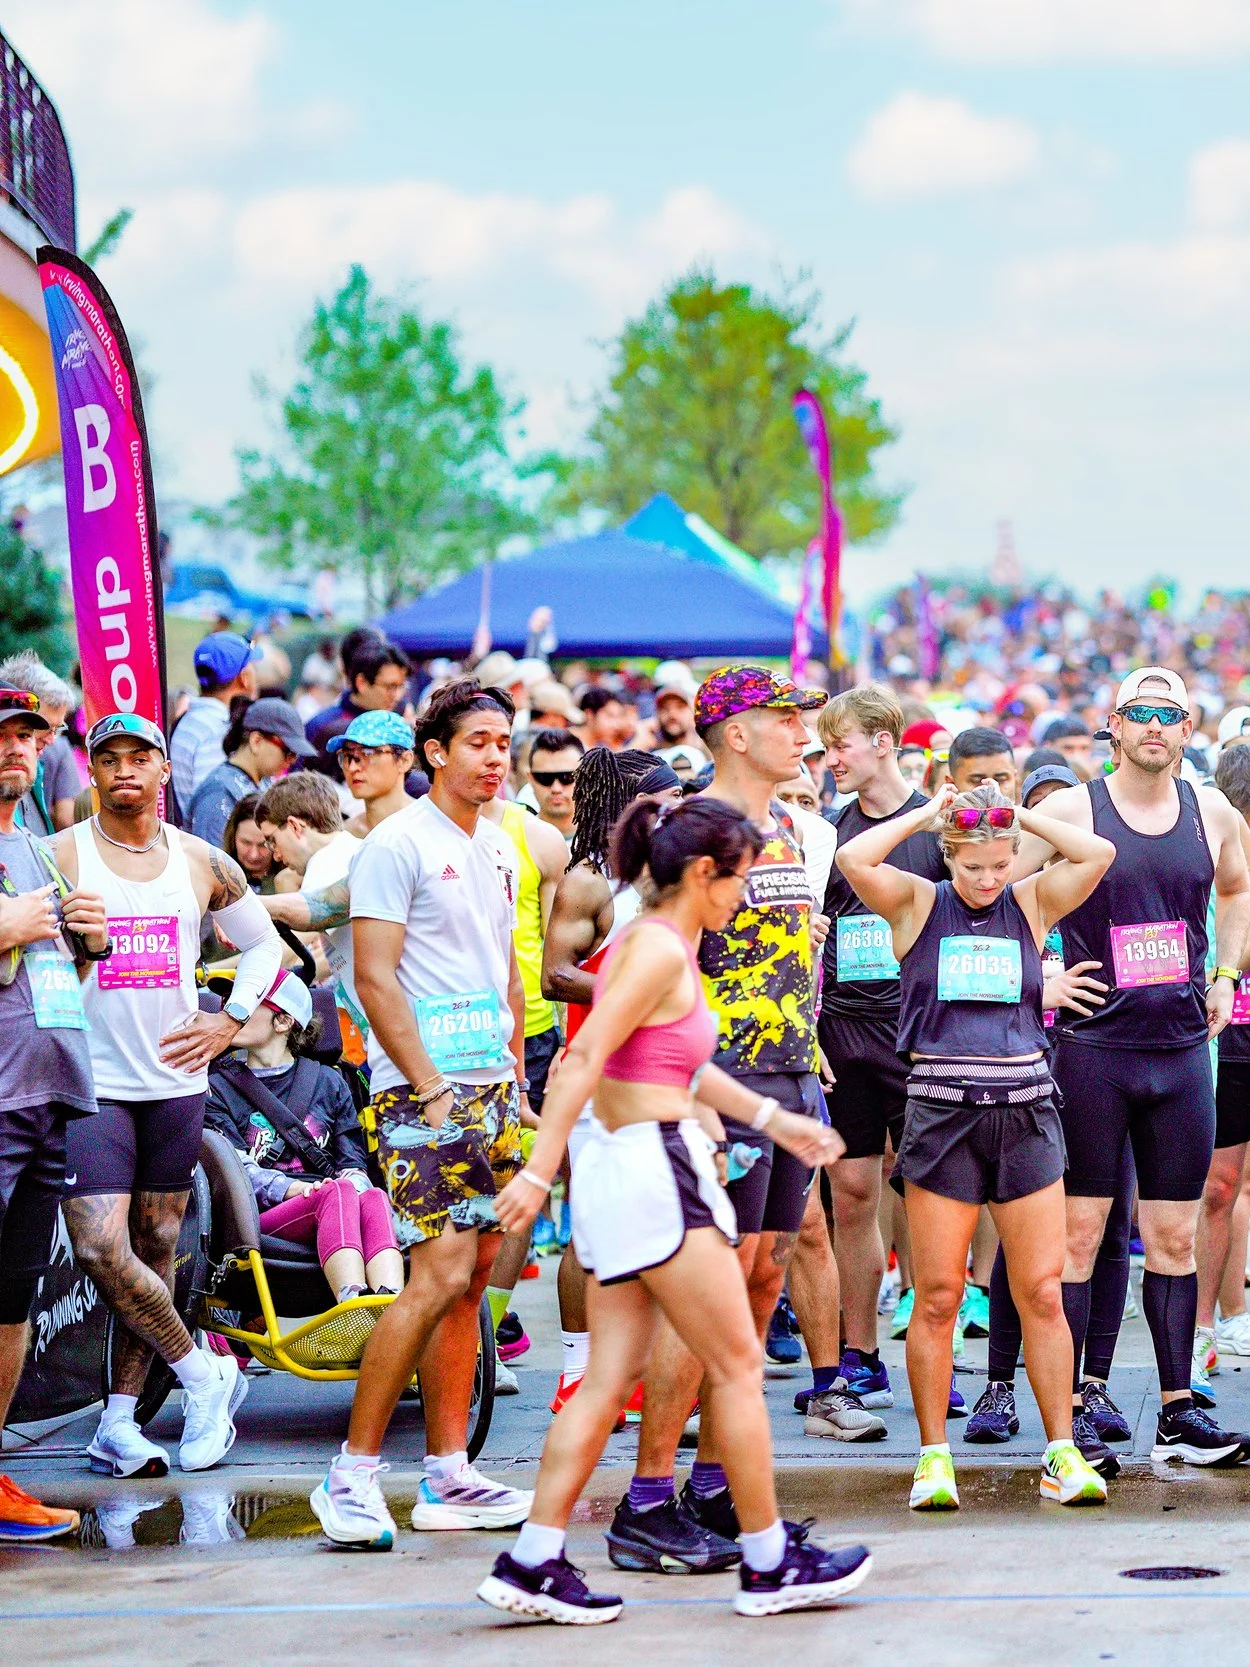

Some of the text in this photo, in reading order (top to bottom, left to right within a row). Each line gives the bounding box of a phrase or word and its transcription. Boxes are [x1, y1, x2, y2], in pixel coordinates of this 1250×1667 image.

[74, 403, 118, 514] B
[754, 887, 779, 899] FUEL
[109, 933, 170, 955] 13092
[972, 944, 991, 952] 26.2
[1123, 938, 1180, 963] 13954
[947, 954, 1013, 976] 26035
[452, 1000, 470, 1010] 26.2
[428, 1010, 493, 1037] 26200
[35, 1280, 84, 1362] RUNNING
